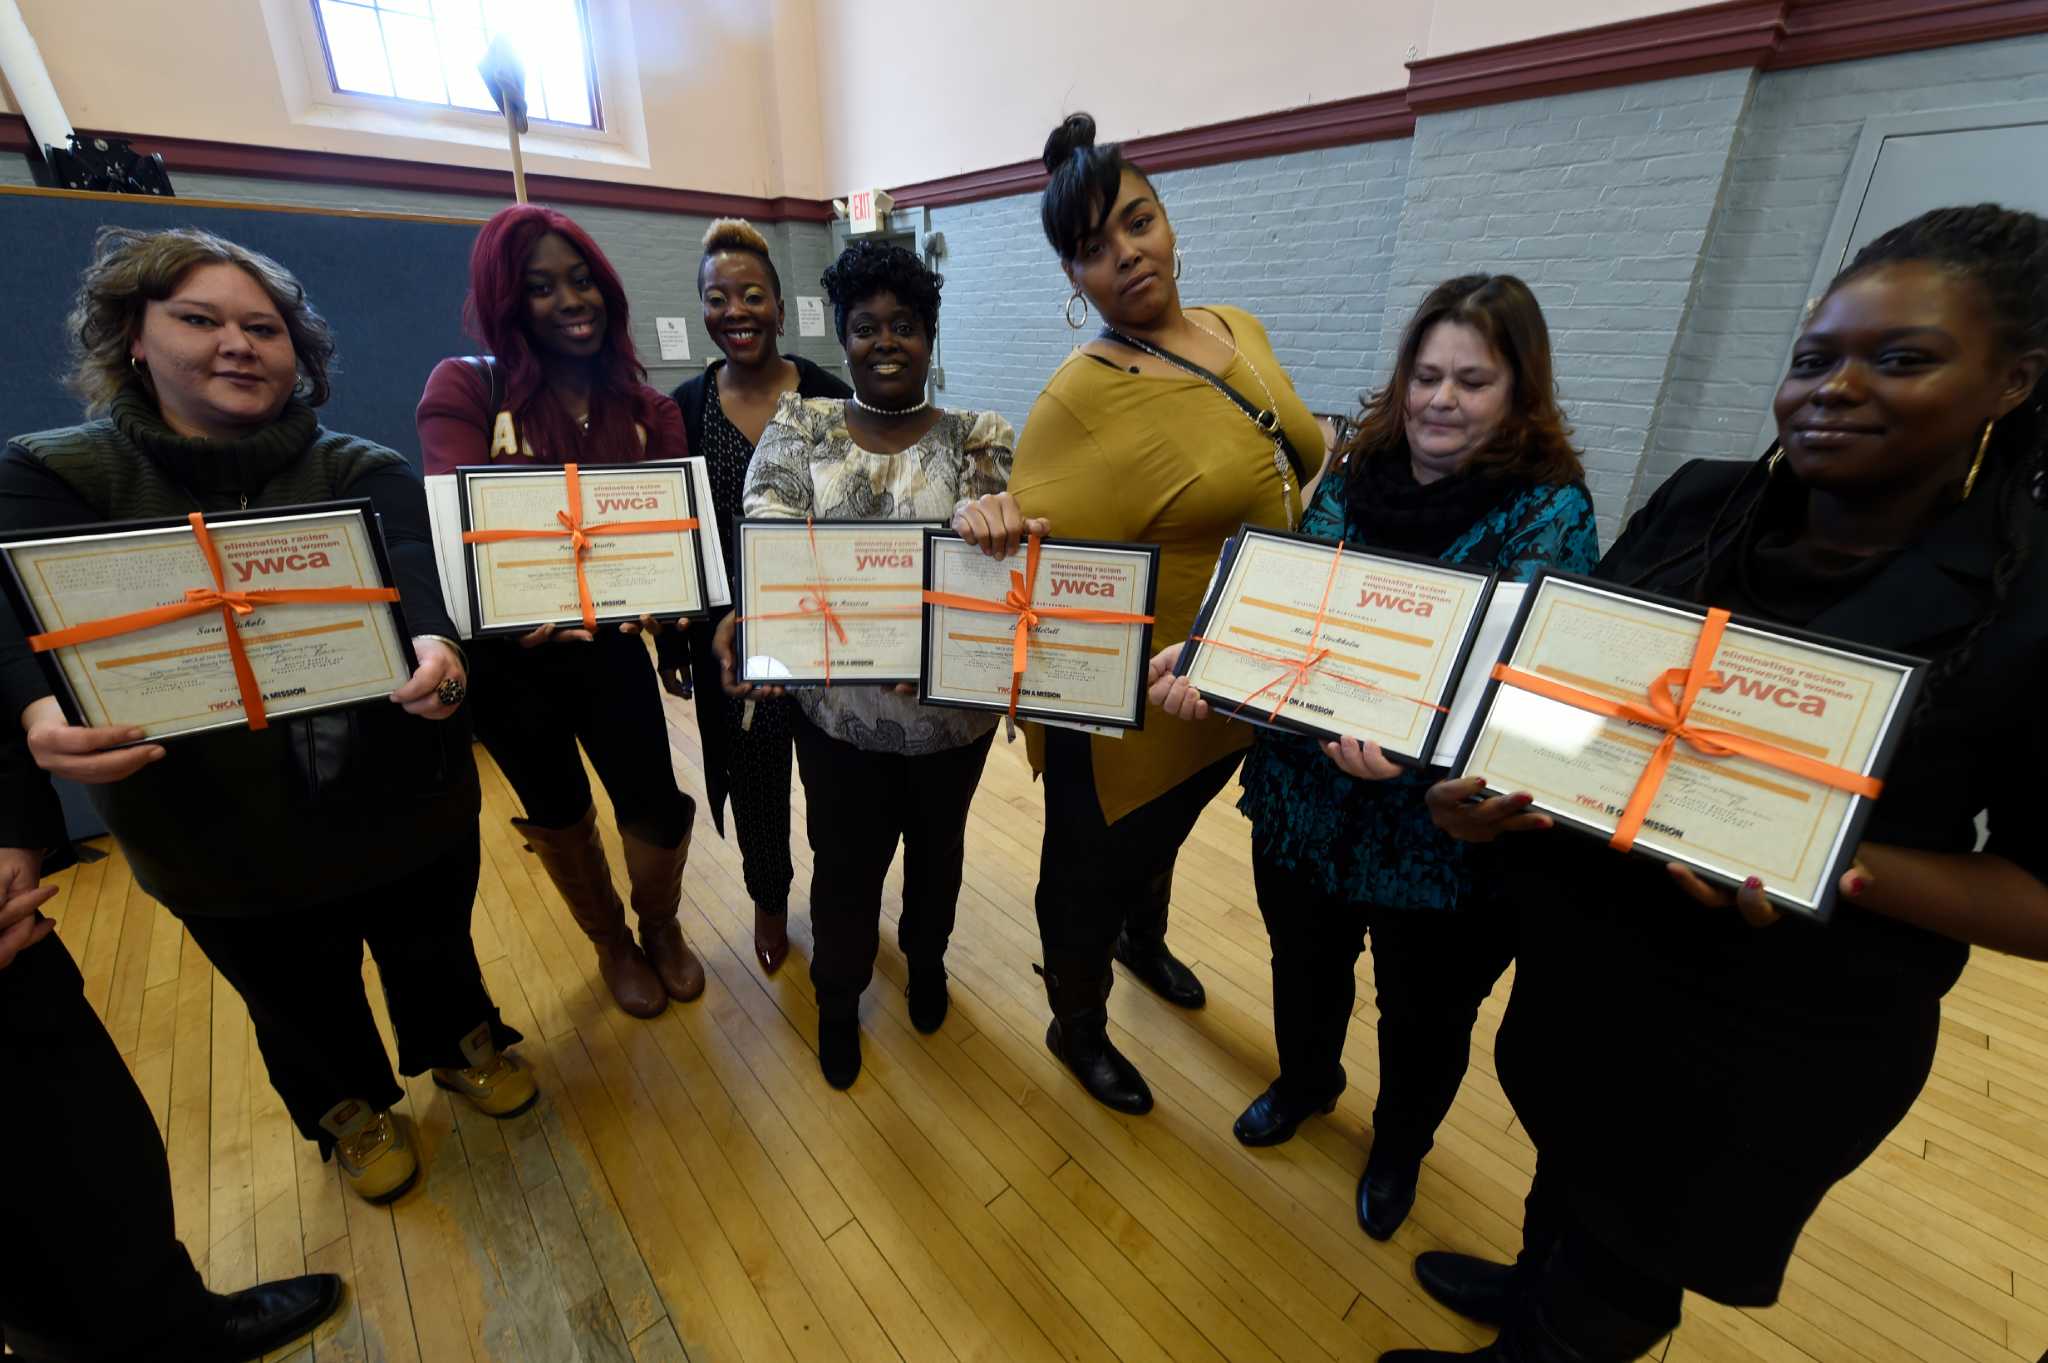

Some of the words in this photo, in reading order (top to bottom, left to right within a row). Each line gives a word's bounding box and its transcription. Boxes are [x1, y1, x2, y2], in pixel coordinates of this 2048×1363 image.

[852, 192, 871, 220] EXIT
[596, 496, 658, 515] ywca
[224, 538, 288, 551] eliminating
[291, 533, 329, 543] racism
[227, 545, 298, 560] empowering
[301, 540, 340, 551] women
[231, 551, 330, 583] ywca
[856, 554, 913, 572] ywca
[1050, 578, 1115, 598] ywca
[1356, 588, 1434, 618] ywca
[1721, 650, 1795, 675] eliminating
[1798, 670, 1847, 688] racism
[1719, 659, 1800, 688] empowering
[1803, 682, 1854, 700] women
[270, 686, 306, 699] MISSION
[1036, 690, 1061, 698] MISSION
[1709, 671, 1827, 718] ywca
[1289, 698, 1299, 706] ON
[1306, 703, 1335, 716] MISSION
[1576, 793, 1605, 813] YWCA
[1605, 804, 1615, 815] IS
[1641, 817, 1684, 839] MISSION
